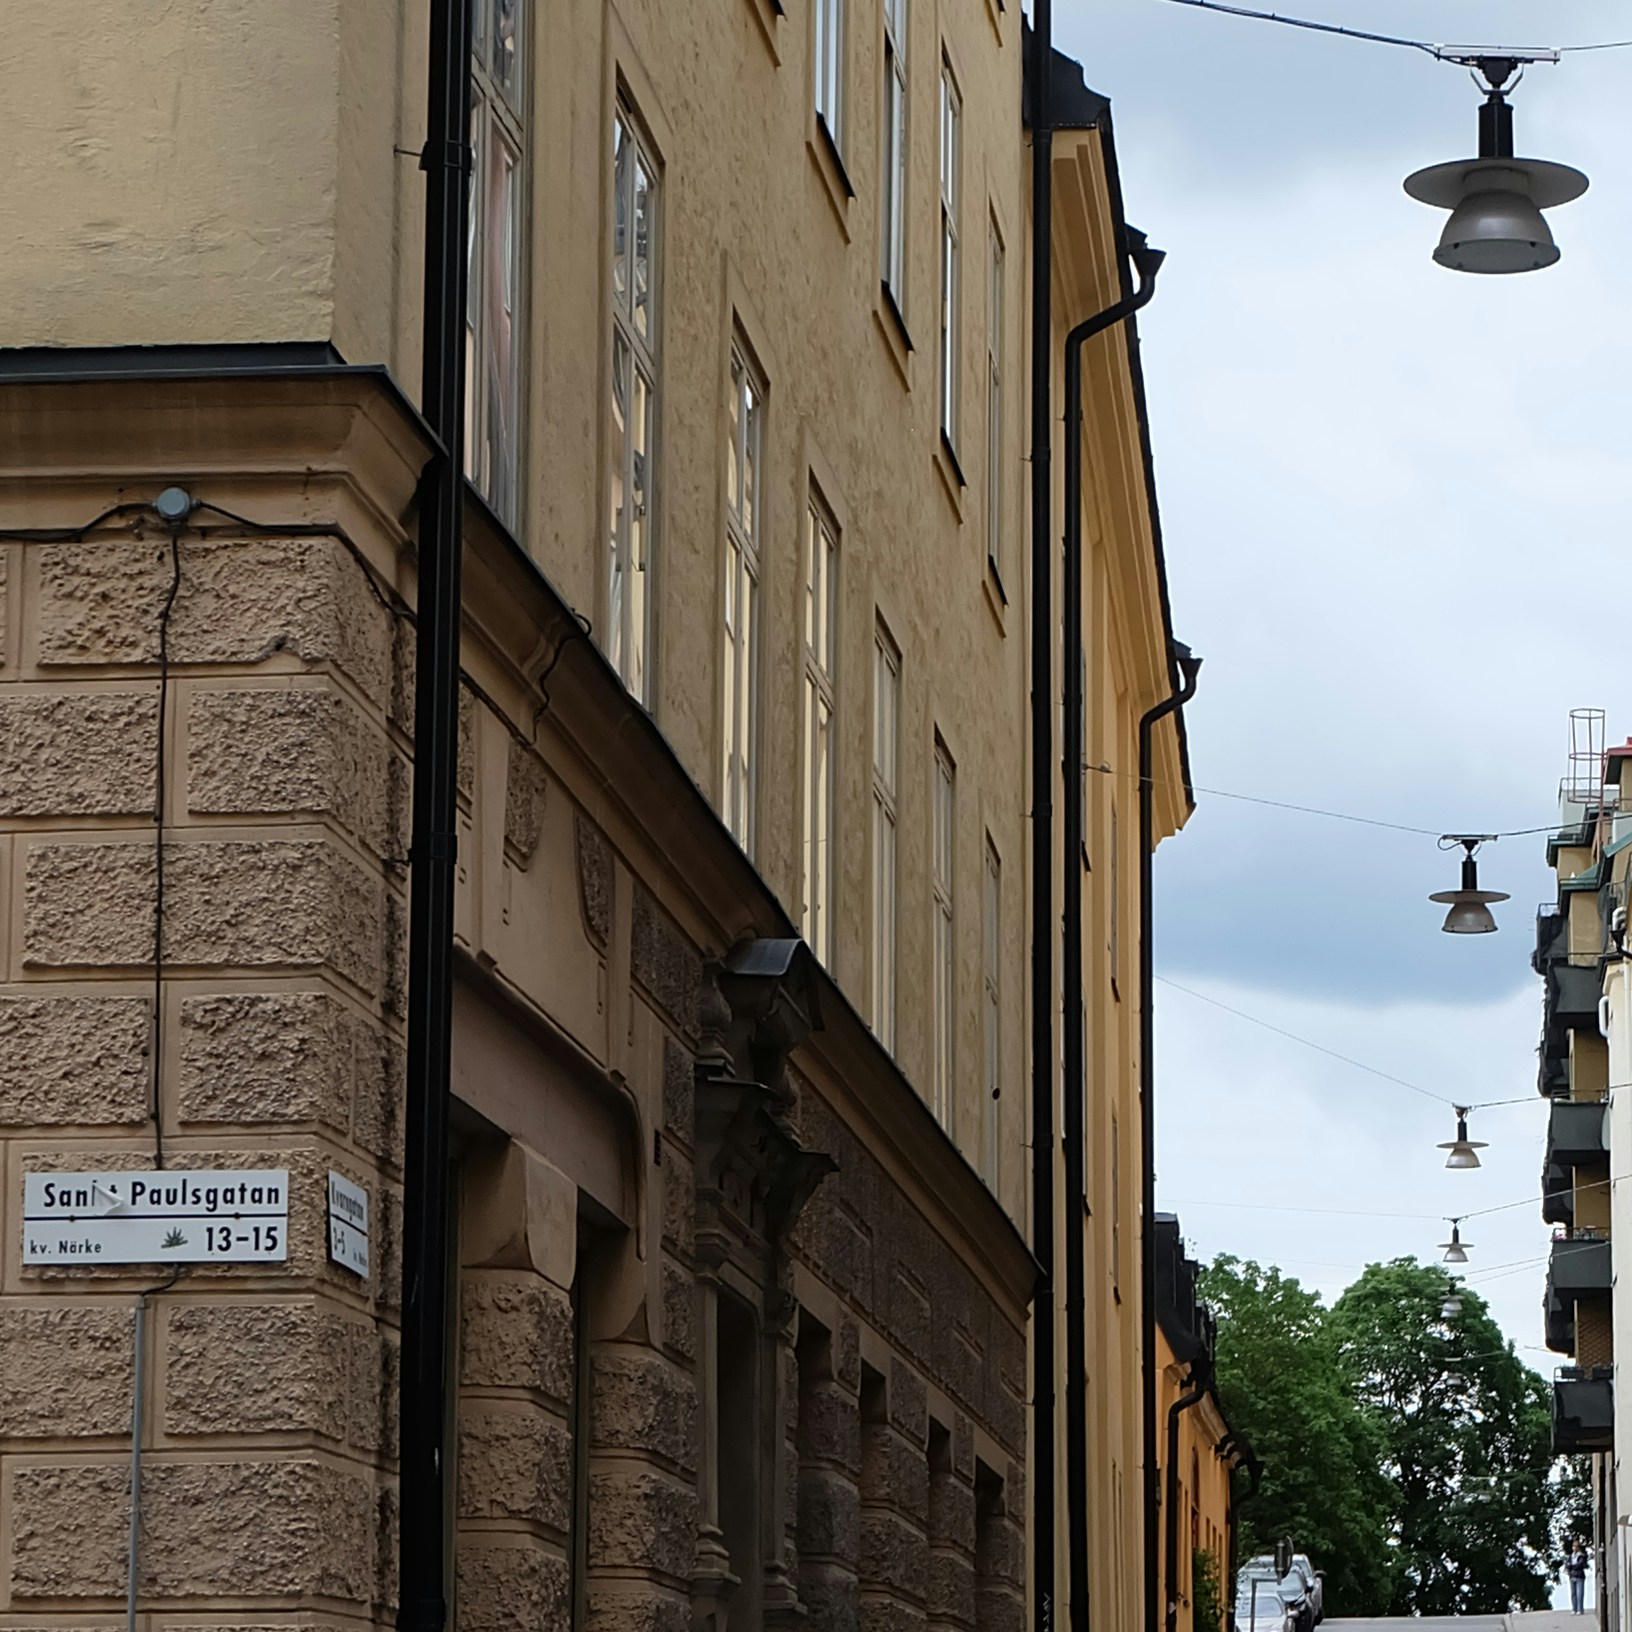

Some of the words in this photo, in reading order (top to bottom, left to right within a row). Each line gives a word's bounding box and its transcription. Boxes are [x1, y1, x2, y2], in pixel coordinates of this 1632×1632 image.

[130, 1178, 280, 1213] Paulsgatan
[30, 1239, 52, 1255] kv.
[58, 1238, 102, 1255] Närke
[206, 1226, 278, 1252] 13-15
